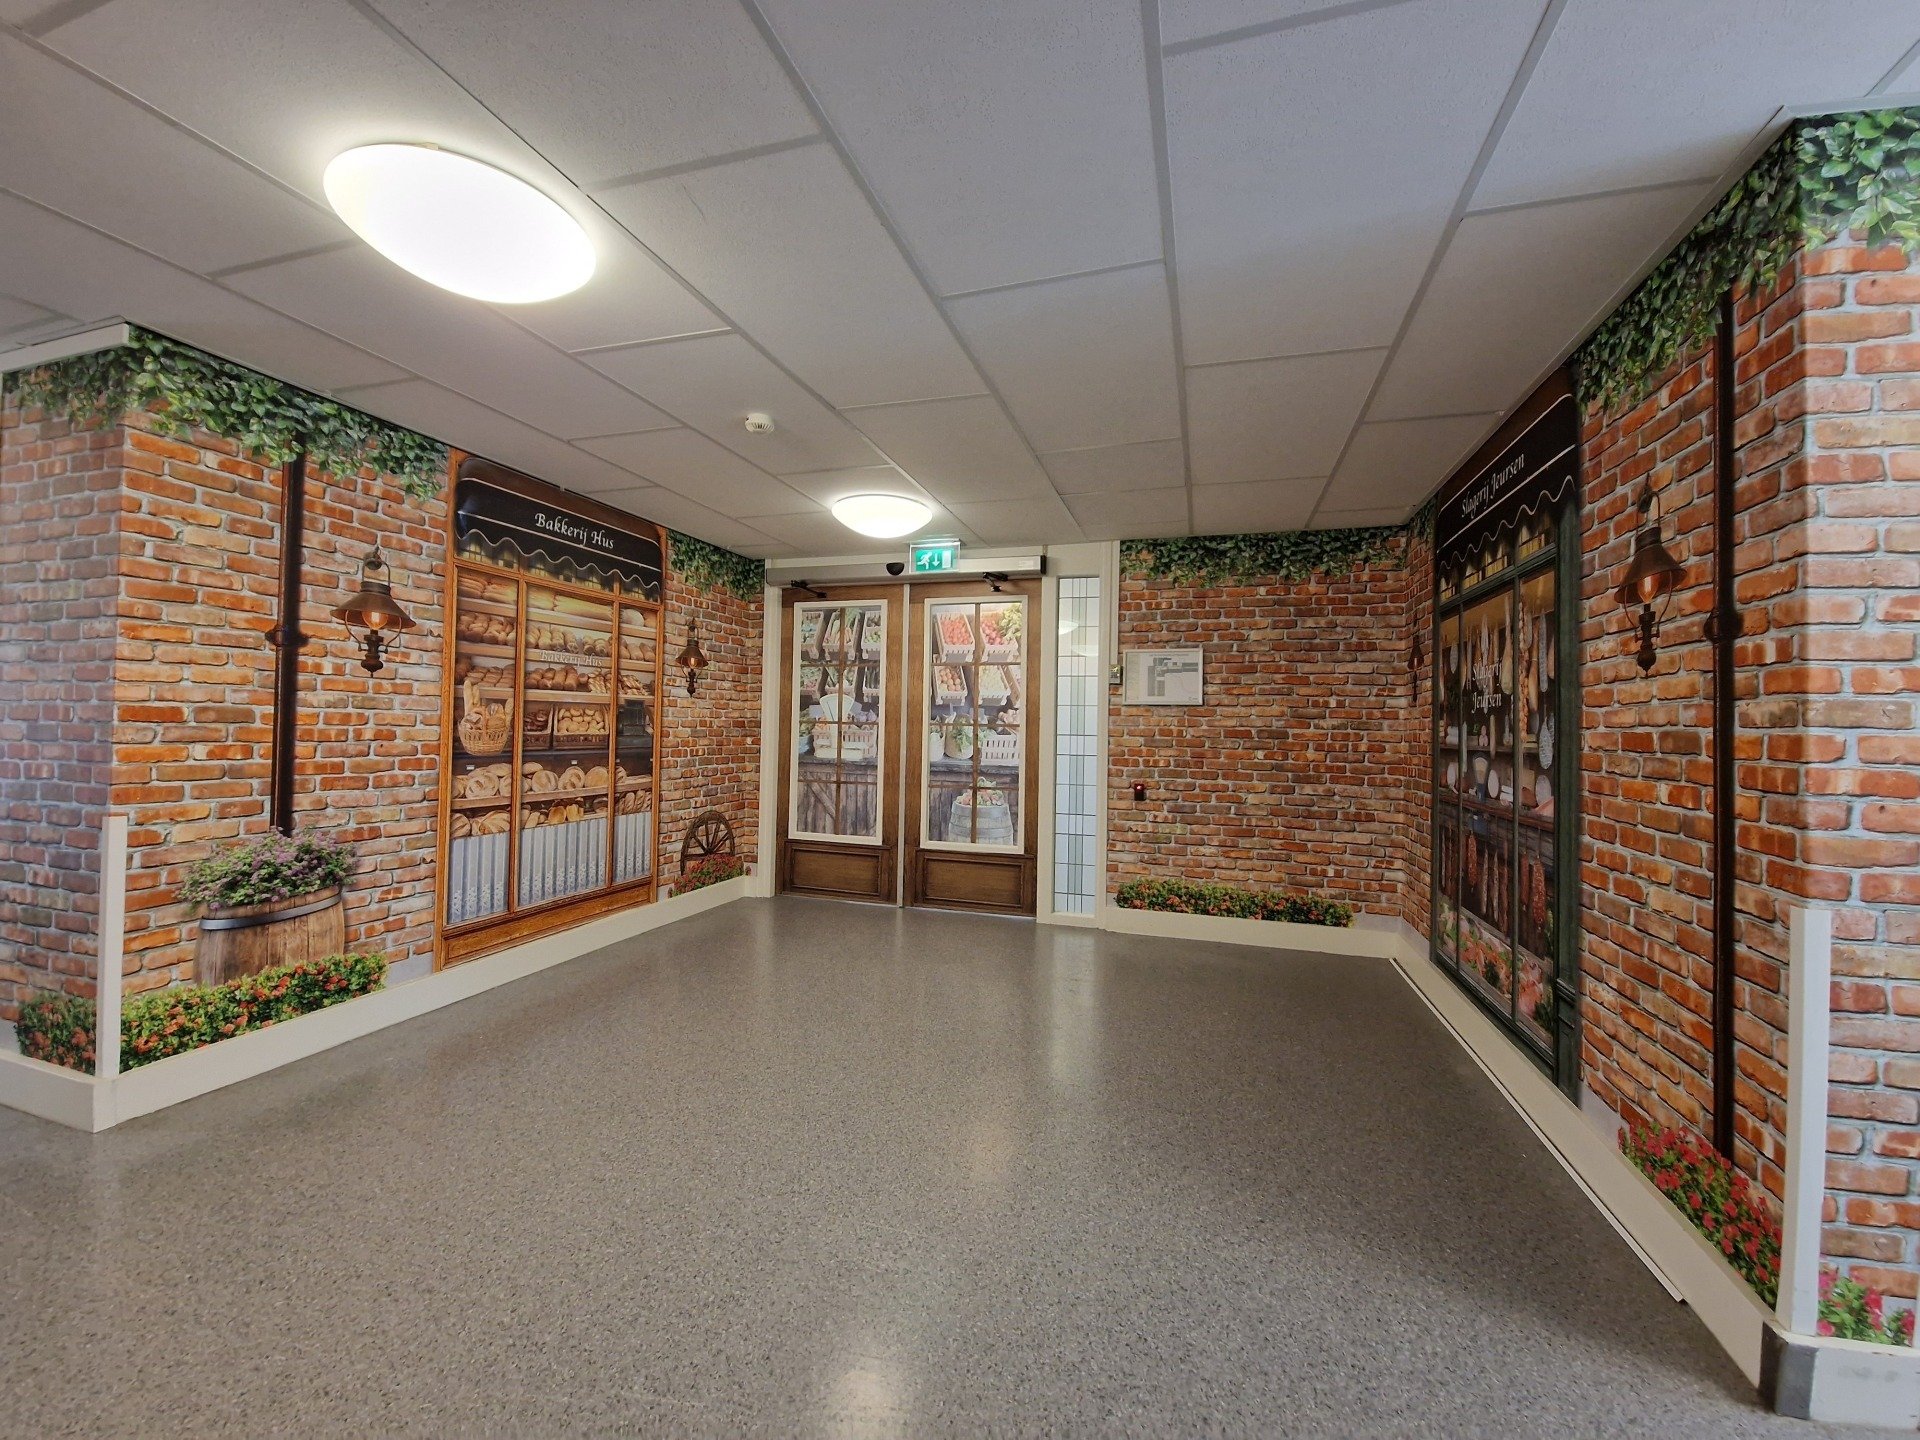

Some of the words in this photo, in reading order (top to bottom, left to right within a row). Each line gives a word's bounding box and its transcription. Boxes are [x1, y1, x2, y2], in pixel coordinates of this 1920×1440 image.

[1461, 478, 1490, 519] Slagerij
[534, 513, 588, 547] Bakkerij
[591, 528, 615, 549] Hus
[539, 650, 580, 667] Bakkerij
[584, 653, 603, 666] Hus
